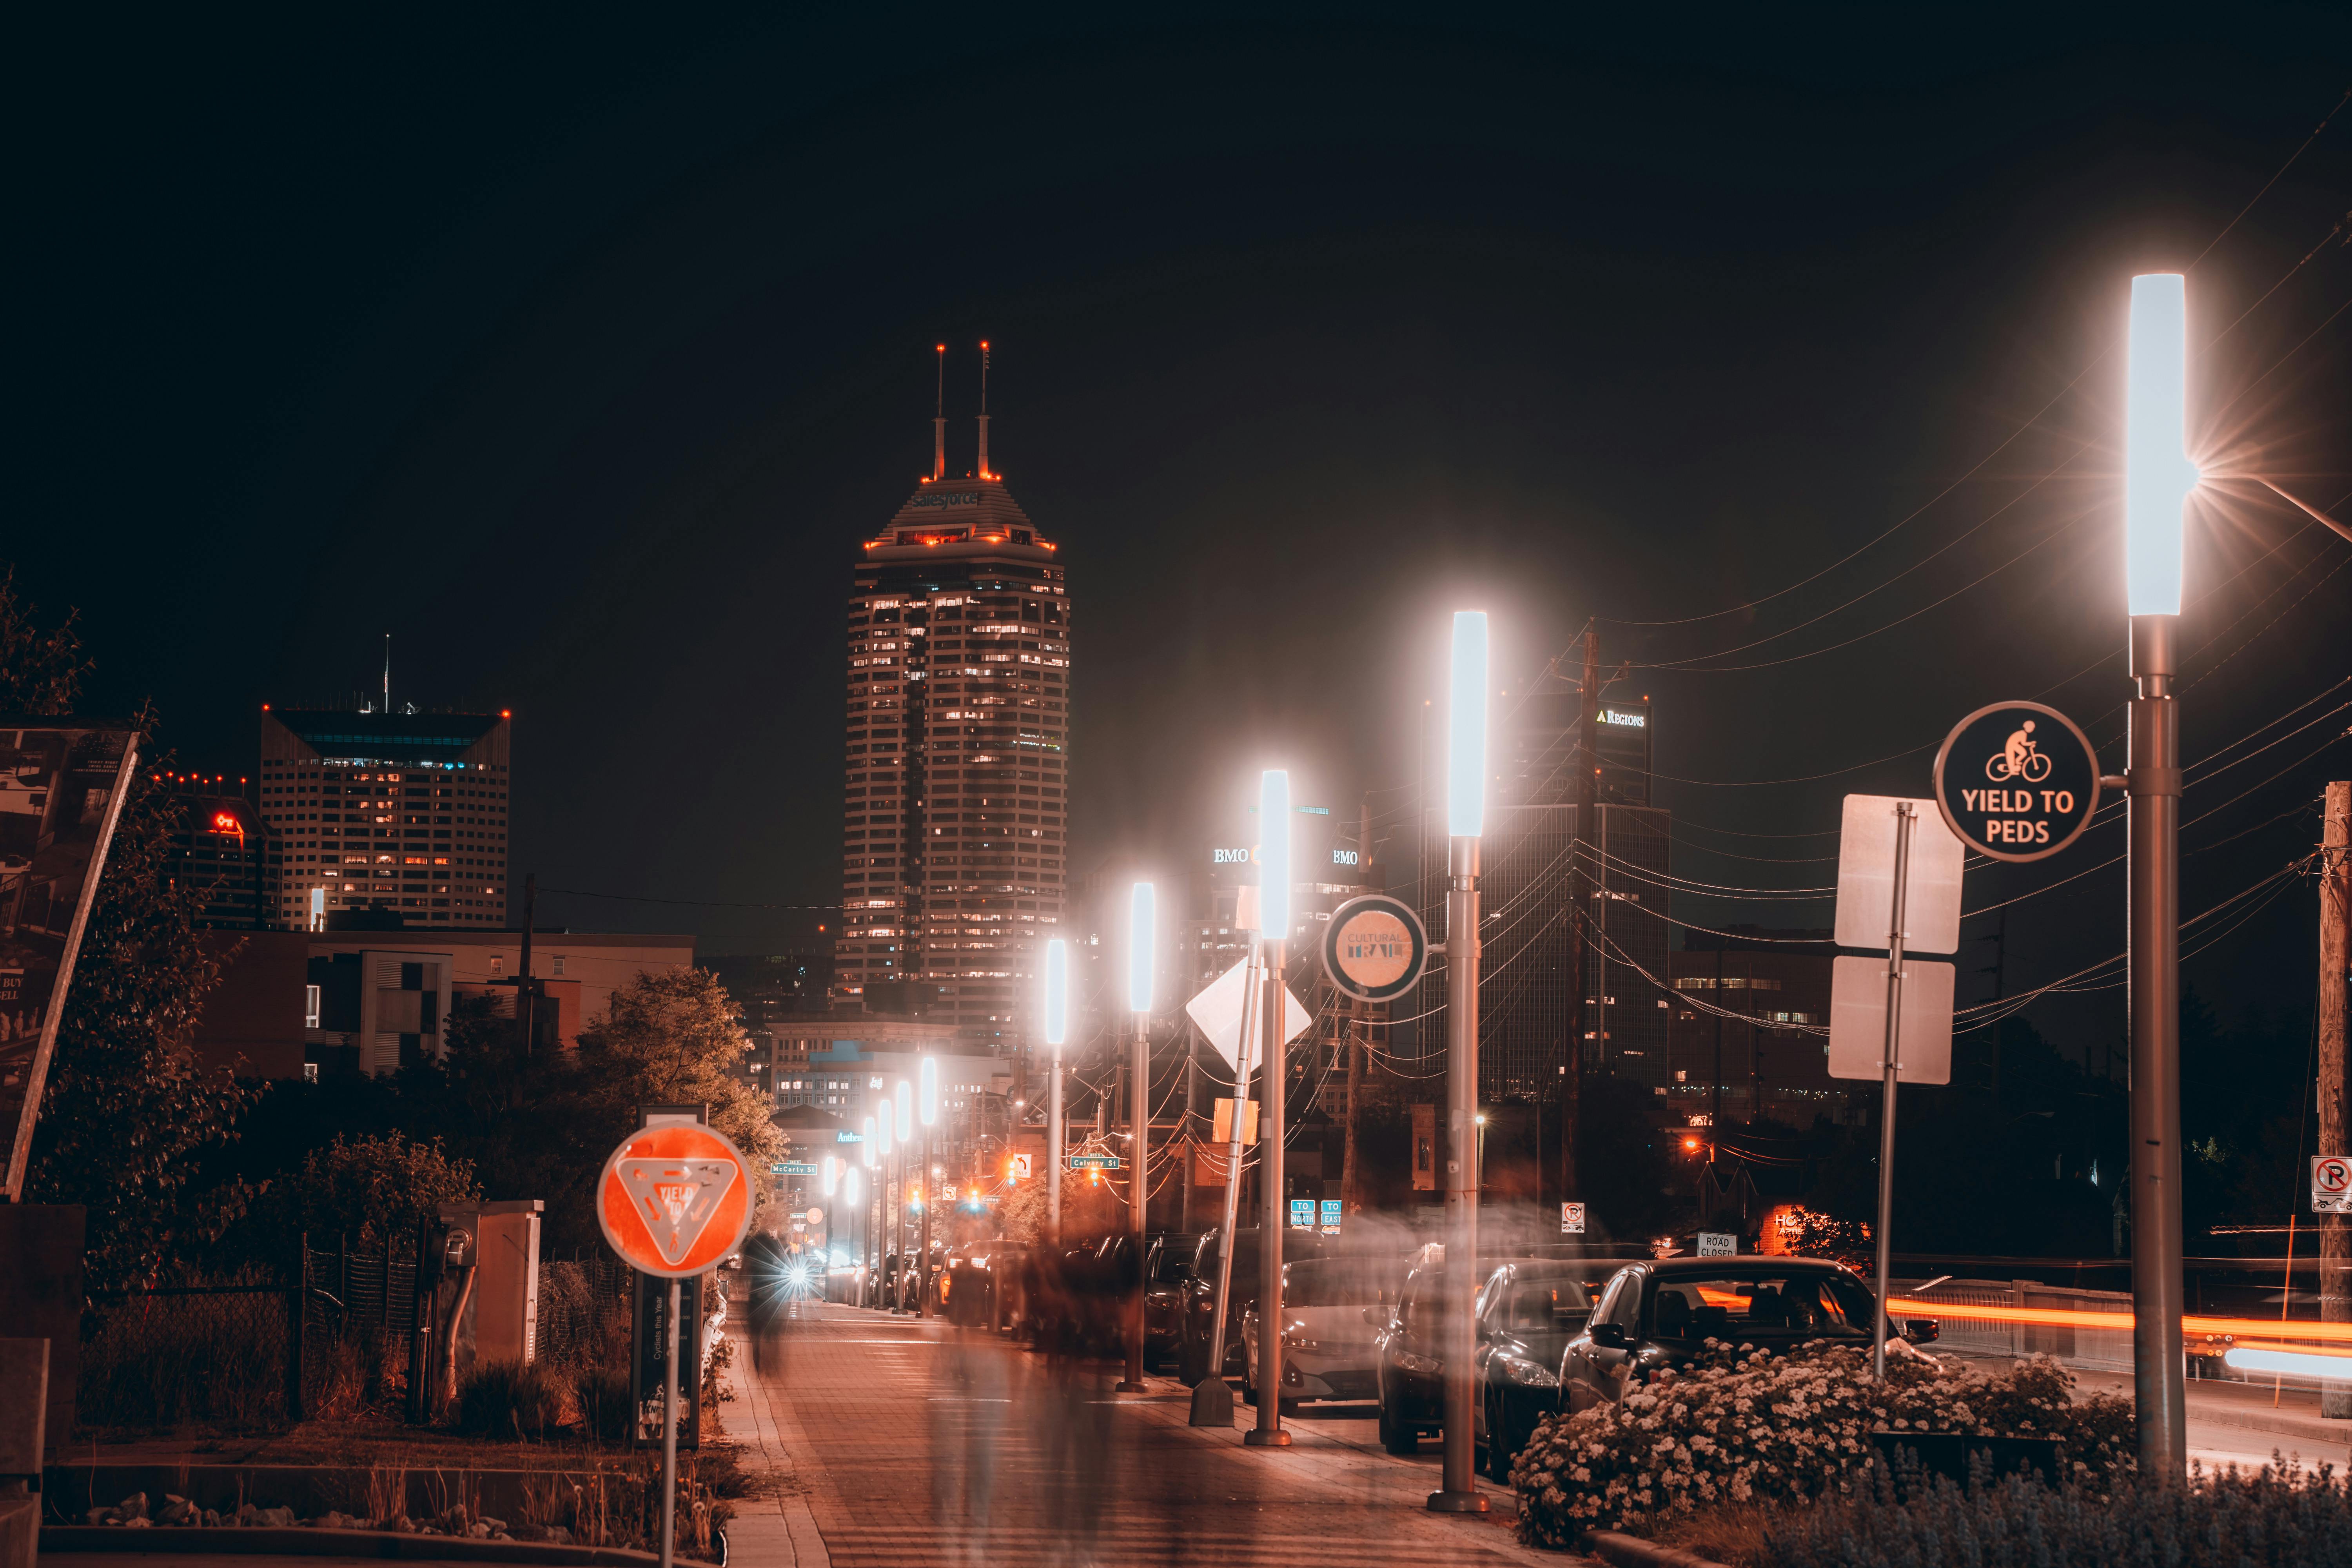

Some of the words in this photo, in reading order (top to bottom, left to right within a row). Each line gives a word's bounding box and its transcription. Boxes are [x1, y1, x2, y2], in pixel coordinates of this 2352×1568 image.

[913, 491, 977, 510] salesforce
[1962, 789, 2033, 812] YIELD
[2040, 791, 2074, 813] TO
[1987, 820, 2049, 843] PEDS
[1214, 849, 1249, 863] BMO
[1333, 850, 1358, 865] BMO
[1348, 934, 1401, 942] CULTURAL
[1348, 944, 1402, 958] TRAIL
[3, 978, 24, 987] BUY
[837, 1132, 864, 1142] Anthem
[660, 1187, 693, 1200] YIELD
[670, 1202, 682, 1215] TO
[1707, 1238, 1729, 1247] ROAD
[1702, 1249, 1733, 1257] CLOSED
[653, 1330, 662, 1360] Cyclists
